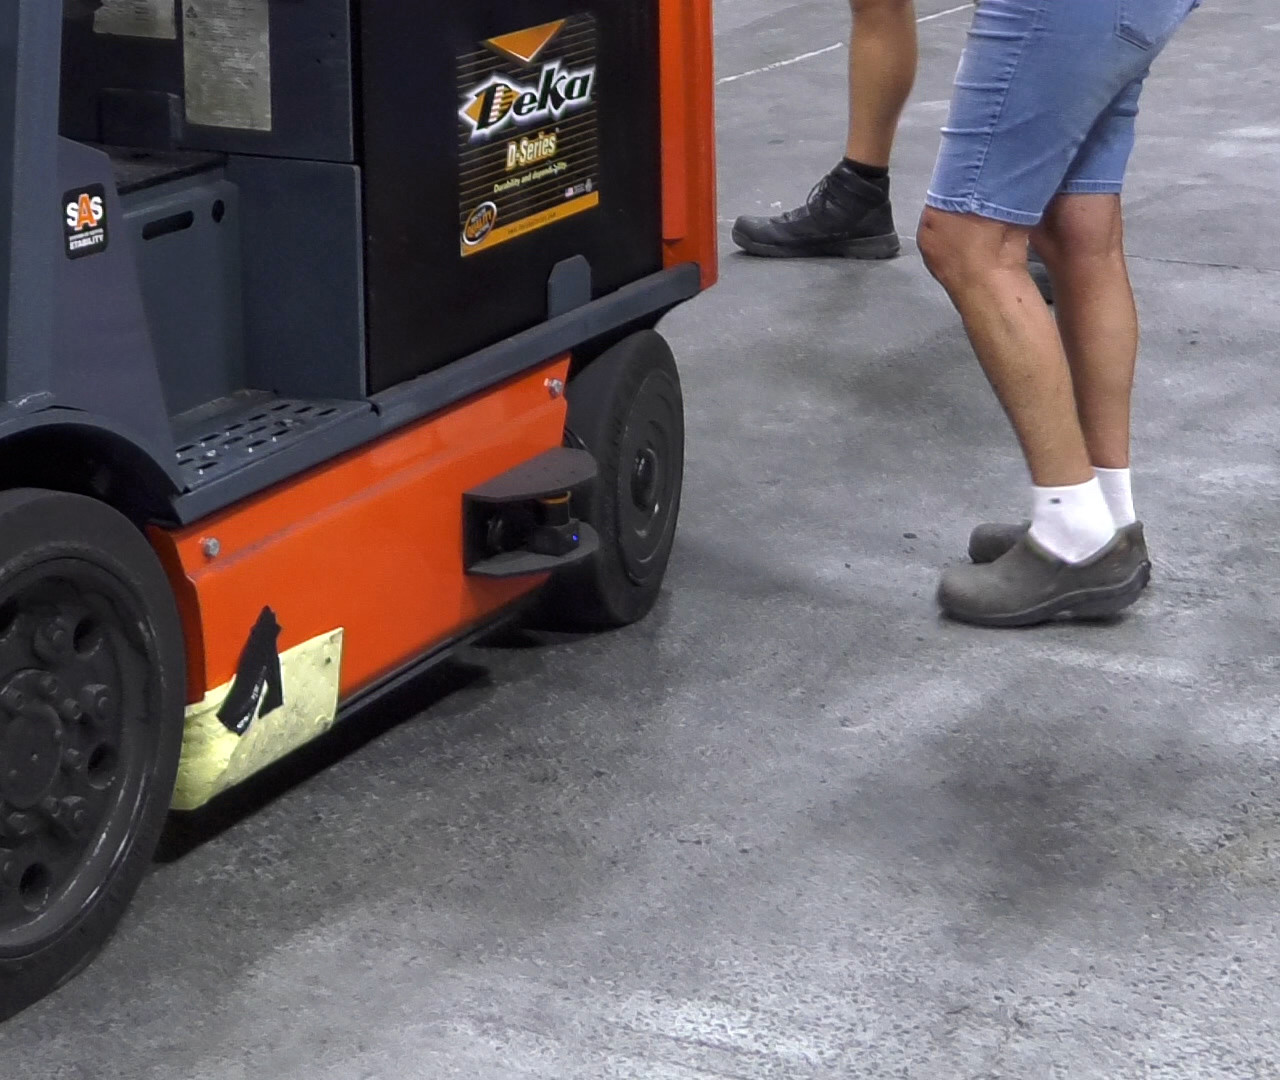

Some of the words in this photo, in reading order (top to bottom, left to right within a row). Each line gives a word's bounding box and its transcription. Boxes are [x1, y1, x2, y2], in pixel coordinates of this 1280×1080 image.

[464, 66, 592, 131] Deka
[505, 131, 557, 171] D-Series
[66, 193, 103, 231] SAS
